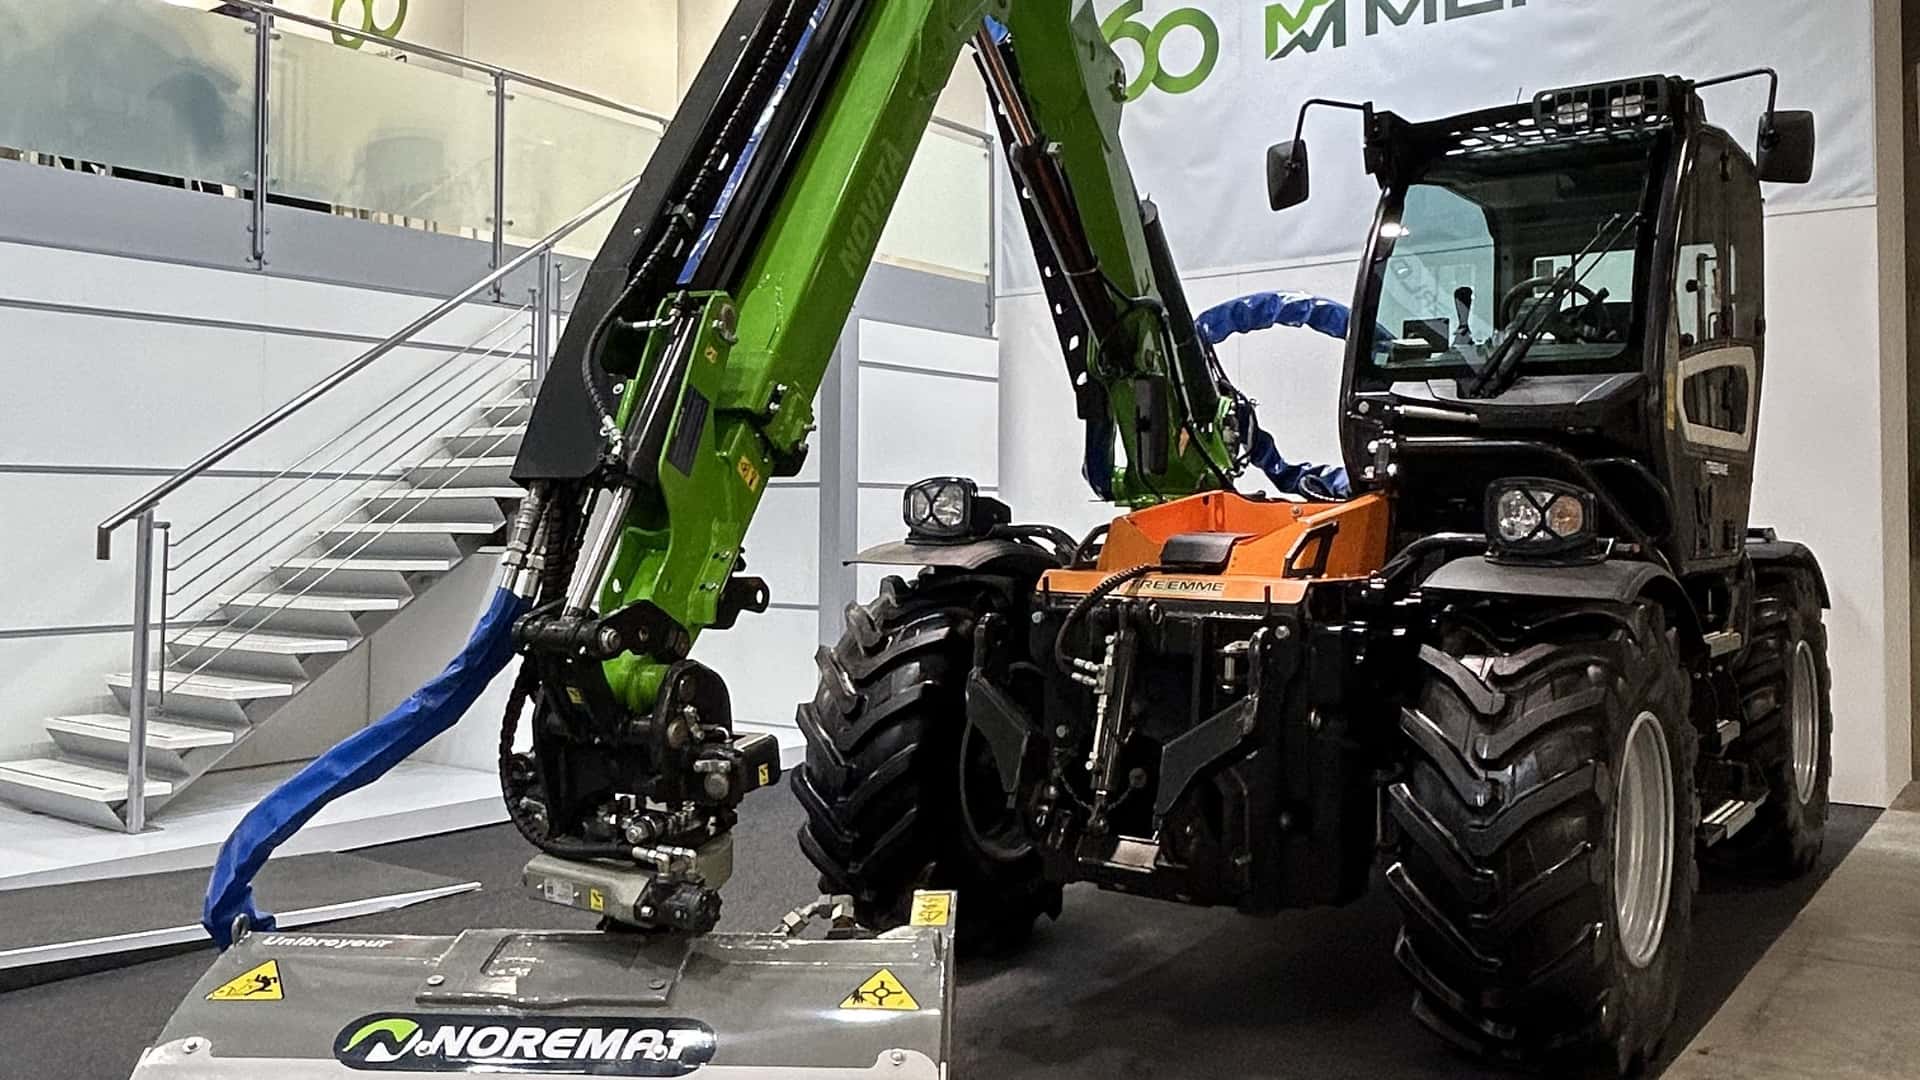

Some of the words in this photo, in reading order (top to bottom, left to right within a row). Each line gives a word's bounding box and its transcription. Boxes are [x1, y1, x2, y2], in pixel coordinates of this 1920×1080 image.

[1100, 0, 1219, 103] 60
[1132, 579, 1225, 593] REEMME
[262, 934, 393, 949] Unibroyeur
[432, 1025, 700, 1060] NOREMAT
